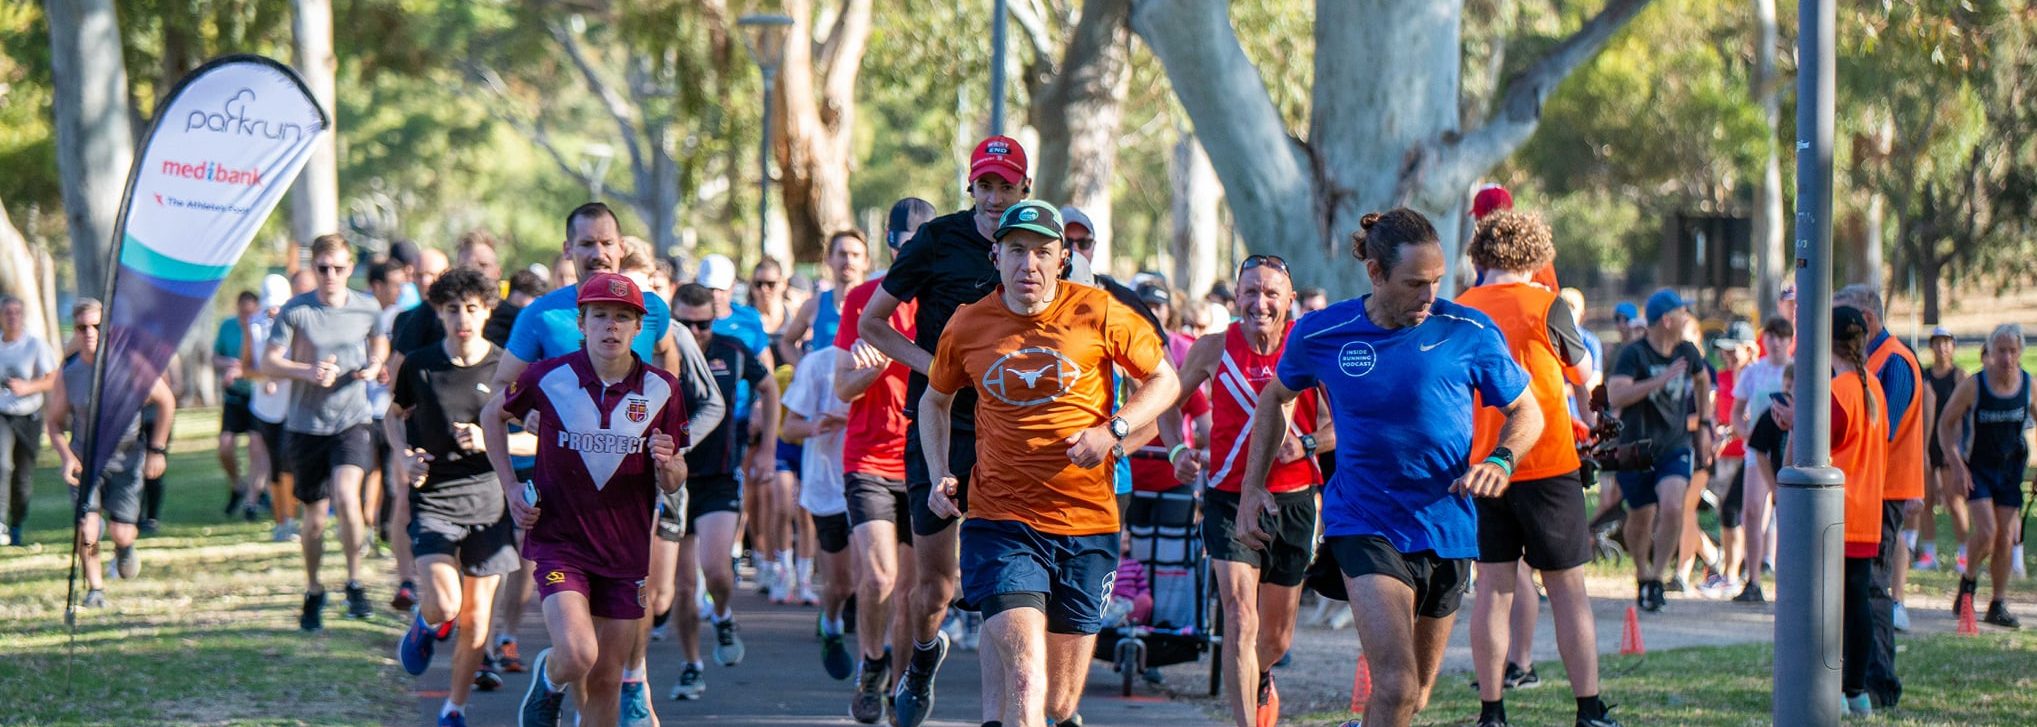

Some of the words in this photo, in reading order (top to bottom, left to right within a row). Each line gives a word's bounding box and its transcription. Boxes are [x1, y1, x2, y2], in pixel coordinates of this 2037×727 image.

[185, 104, 302, 142] parkrun
[162, 160, 264, 187] medibank
[167, 197, 184, 207] The
[557, 430, 647, 455] PROSPECT
